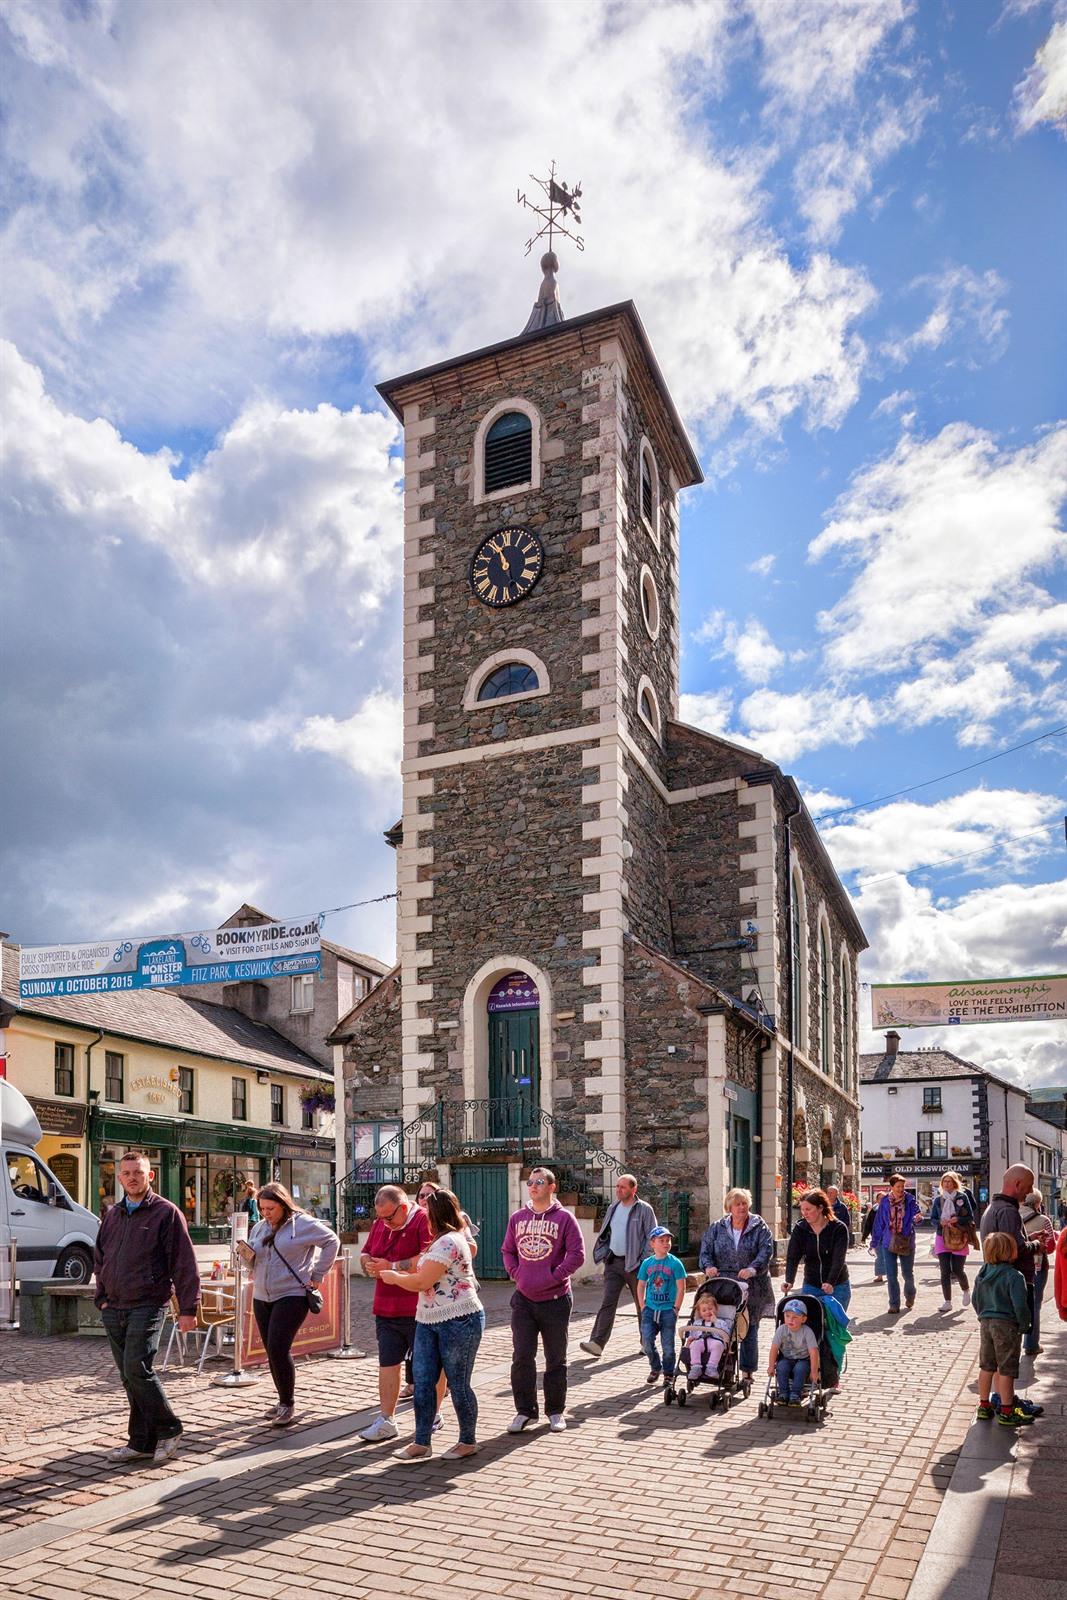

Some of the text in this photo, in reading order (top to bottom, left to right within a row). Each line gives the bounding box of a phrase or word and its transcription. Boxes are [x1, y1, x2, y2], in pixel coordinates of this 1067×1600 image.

[216, 921, 319, 946] BOOKMYRIDE.co.uk
[226, 936, 320, 955] VISIT FOR DETAILS AND SIGN UP
[21, 947, 110, 964] FULLY SUPPORTED & ORGANISED
[148, 955, 176, 965] LAKELAND
[21, 960, 94, 975] CROSS COUNTRY BIKE RIDE
[142, 962, 183, 975] MONSTER
[191, 962, 272, 981] FITZ PARK, KESWICK
[21, 975, 133, 995] SUNDAY 4 OCTOBER 2015
[151, 973, 174, 983] MILES
[990, 997, 1014, 1005] FELLS
[948, 1002, 1065, 1016] SEE THE EXHIBITION
[130, 1076, 182, 1098] ESTABLISHED
[914, 1164, 969, 1173] KESWICKIAN
[309, 1324, 330, 1333] SHOP
